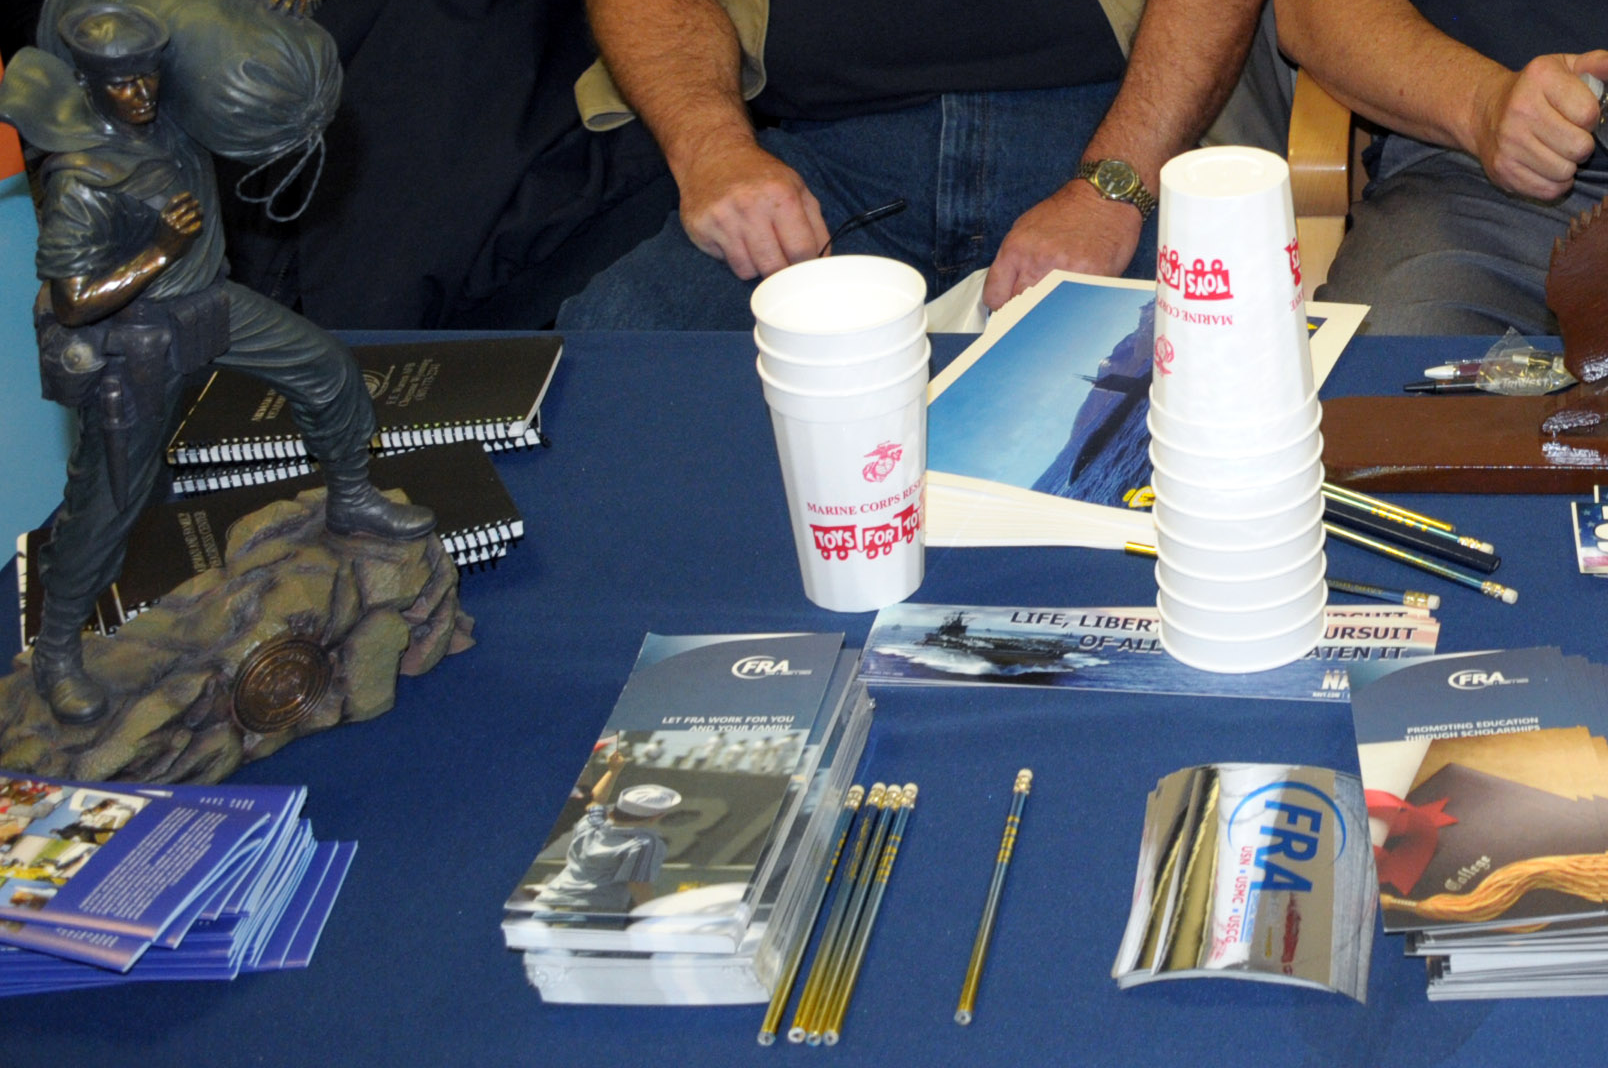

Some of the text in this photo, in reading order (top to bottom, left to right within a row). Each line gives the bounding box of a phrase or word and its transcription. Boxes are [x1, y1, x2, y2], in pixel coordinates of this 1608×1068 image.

[1160, 259, 1229, 296] TOYS FOR
[1157, 296, 1233, 326] MARINE CORP
[807, 494, 901, 516] MARINE CORPS
[814, 529, 855, 549] TOYS
[864, 529, 895, 546] FOR
[1010, 611, 1418, 640] LIFE, LIBER URSUIT
[1079, 634, 1114, 650] OF
[1118, 638, 1163, 654] ALL
[1303, 646, 1372, 661] ATEN
[741, 660, 790, 674] FRA
[1459, 671, 1505, 685] FRA
[662, 716, 681, 724] LET
[684, 716, 705, 724] FRA
[771, 715, 795, 723] YOU
[688, 724, 792, 732] AND YOUR FAMILY
[1407, 717, 1539, 734] PROMOTING EDUCATION
[1404, 725, 1541, 742] THROUGH SCHOLARSHIPS
[1250, 800, 1323, 892] FRA
[1444, 855, 1491, 891] College
[1225, 845, 1254, 943] USN USMC USCG
